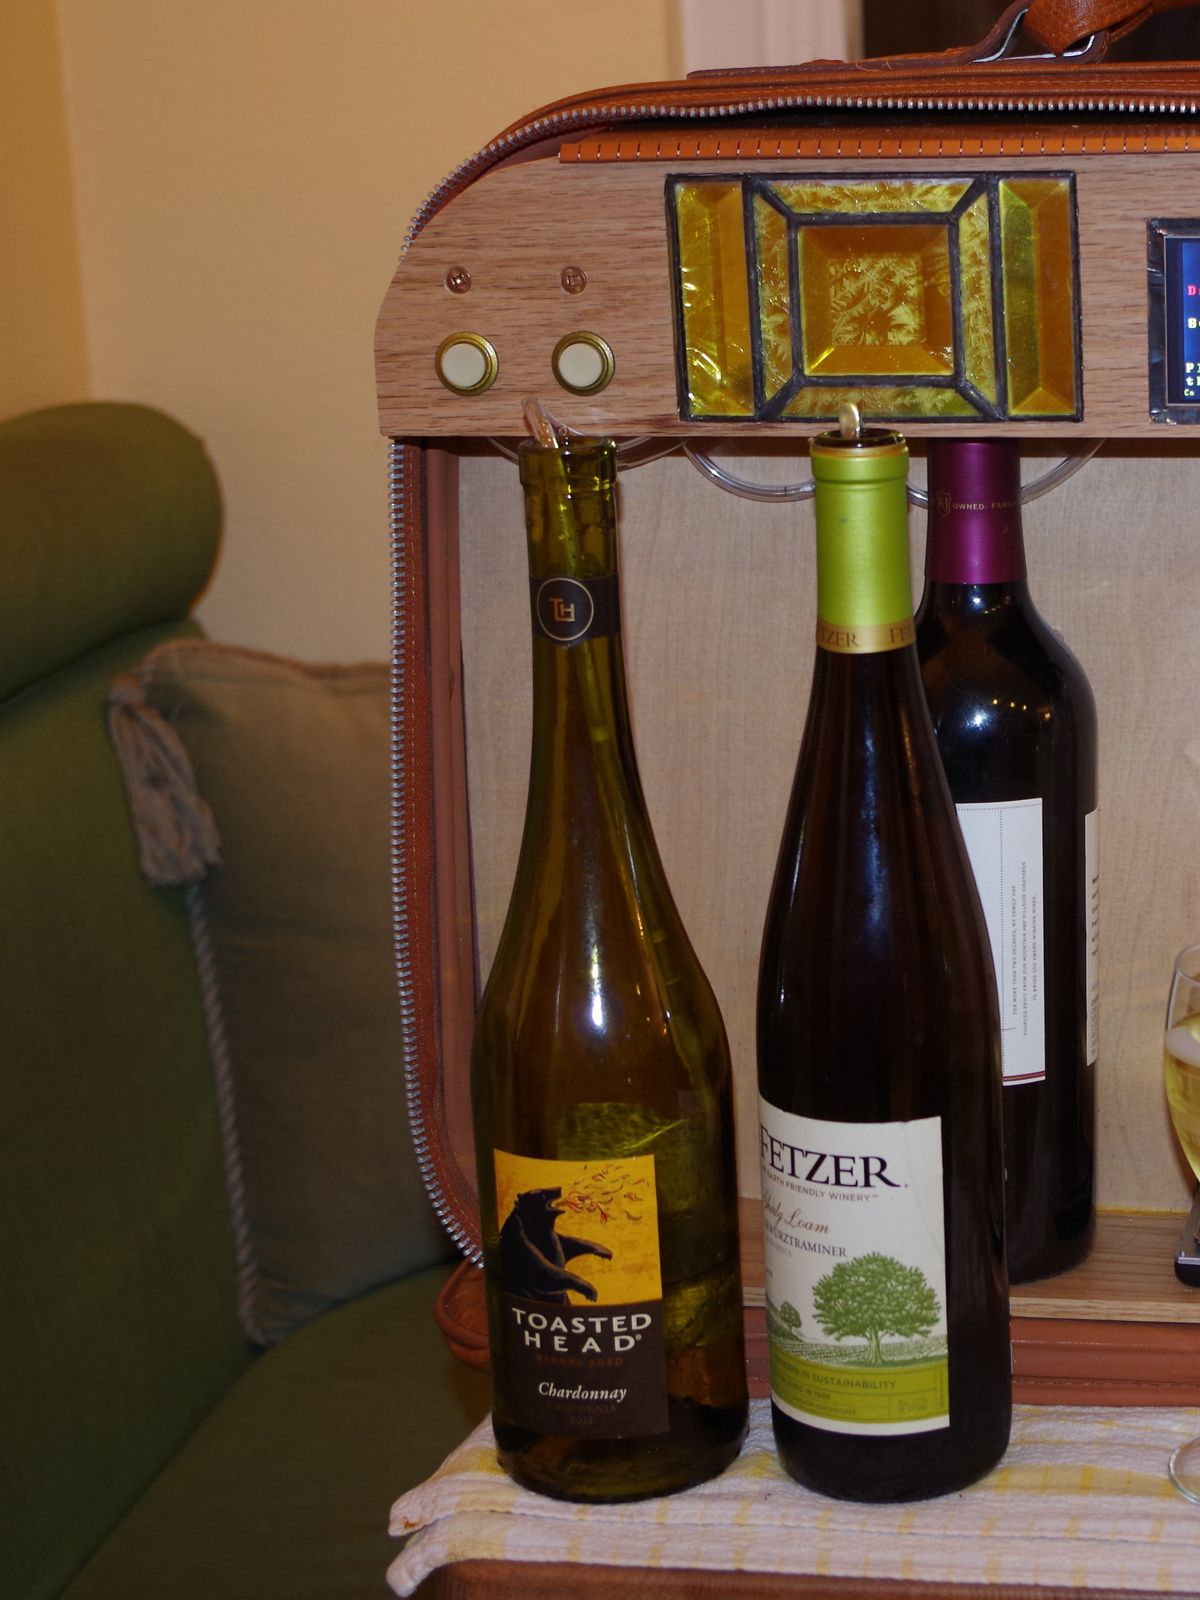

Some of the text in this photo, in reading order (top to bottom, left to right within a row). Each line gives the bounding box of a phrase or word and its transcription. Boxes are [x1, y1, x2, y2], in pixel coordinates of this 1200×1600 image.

[760, 1125, 901, 1189] FETZER
[785, 1180, 826, 1199] FRIENDLY
[829, 1191, 871, 1202] WINERY
[784, 1207, 830, 1234] Loam
[511, 1307, 652, 1334] TOASTED
[538, 1381, 628, 1404] Chardonnay
[811, 1373, 897, 1390] SUSTAINABILITY
